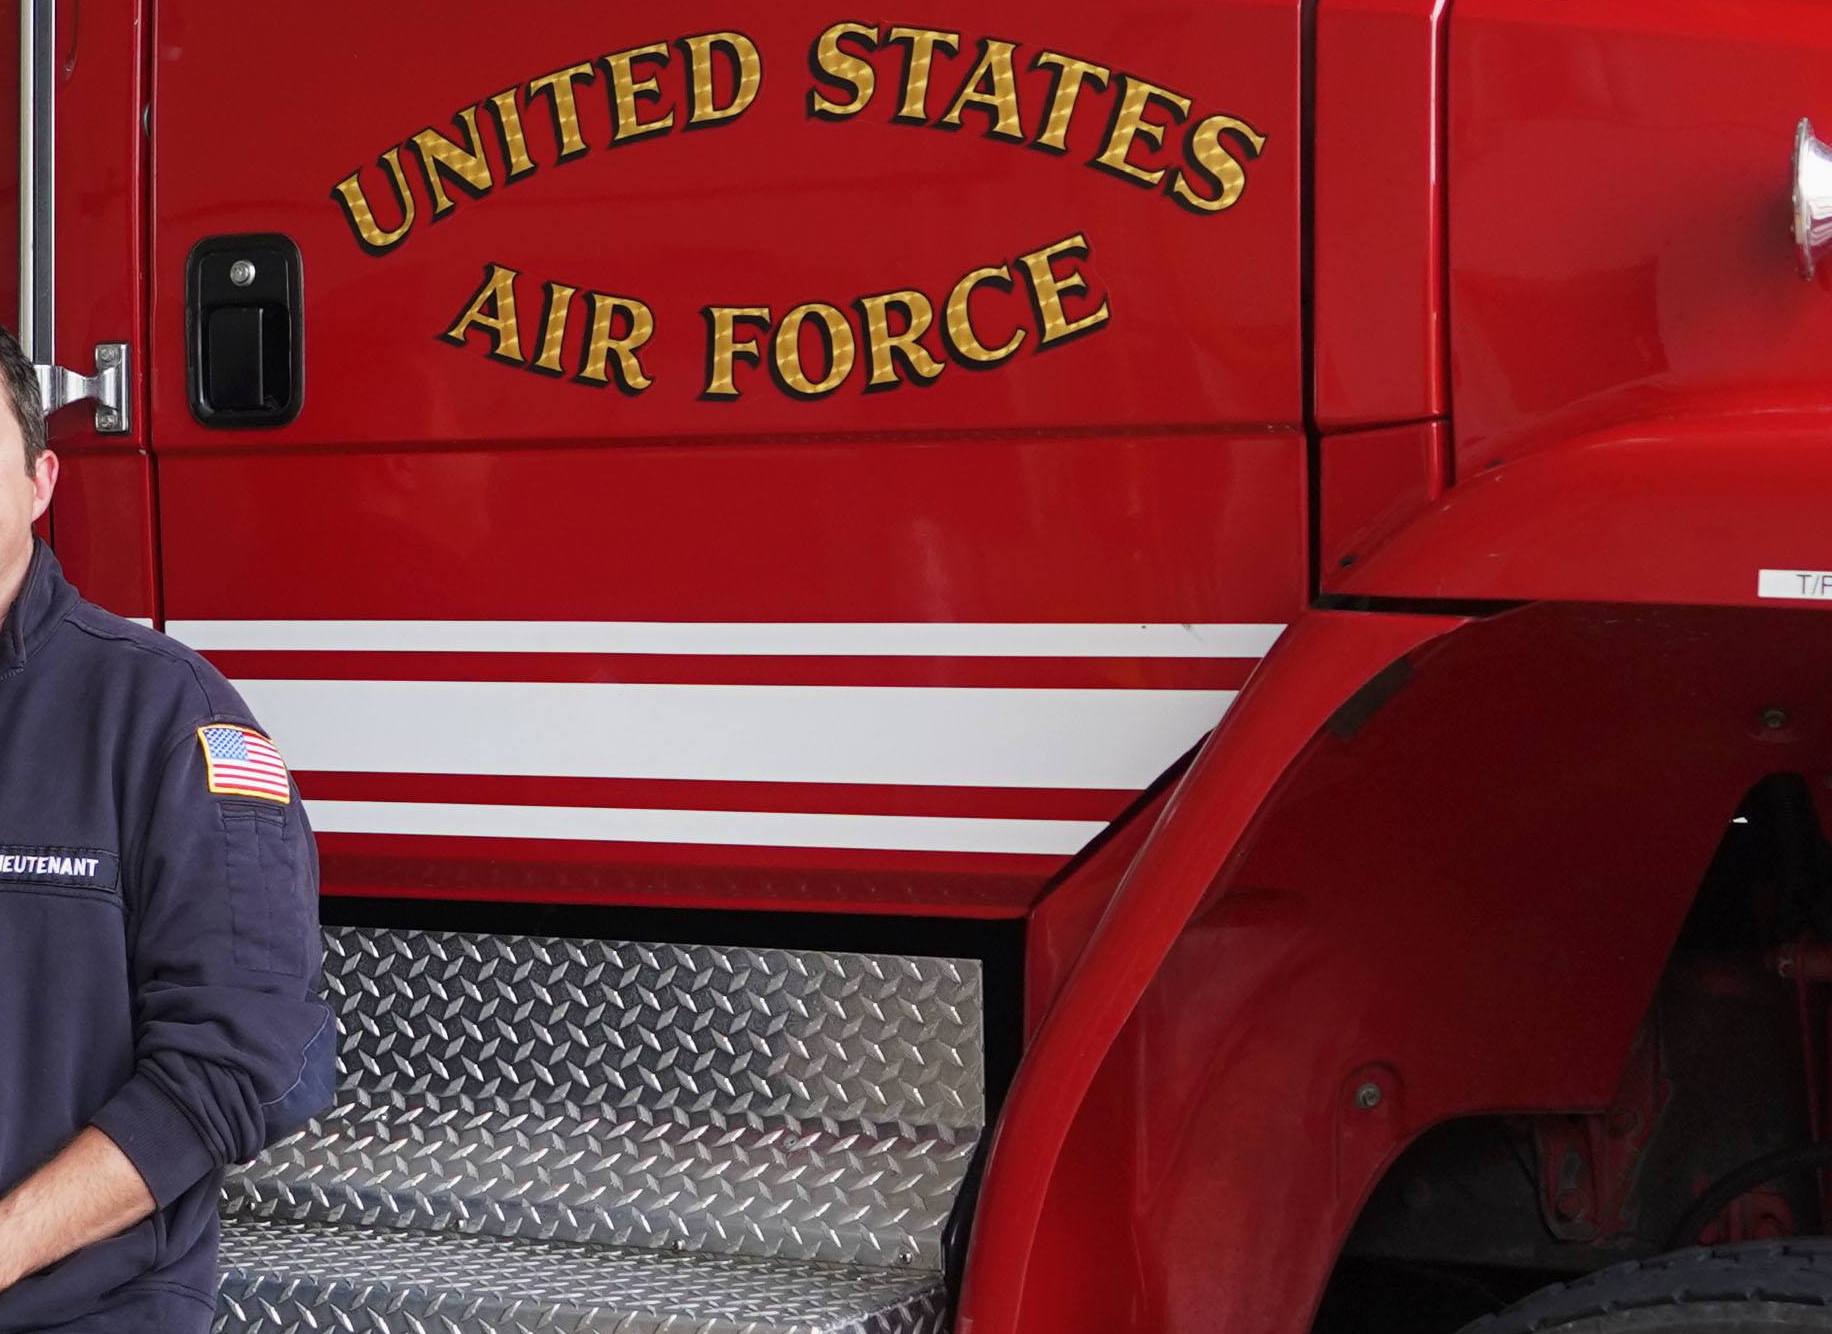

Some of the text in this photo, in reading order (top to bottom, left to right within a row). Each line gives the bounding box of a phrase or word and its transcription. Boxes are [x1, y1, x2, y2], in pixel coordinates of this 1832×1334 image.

[332, 21, 1267, 256] UNITED STATES
[441, 232, 1111, 401] AIR FORCE
